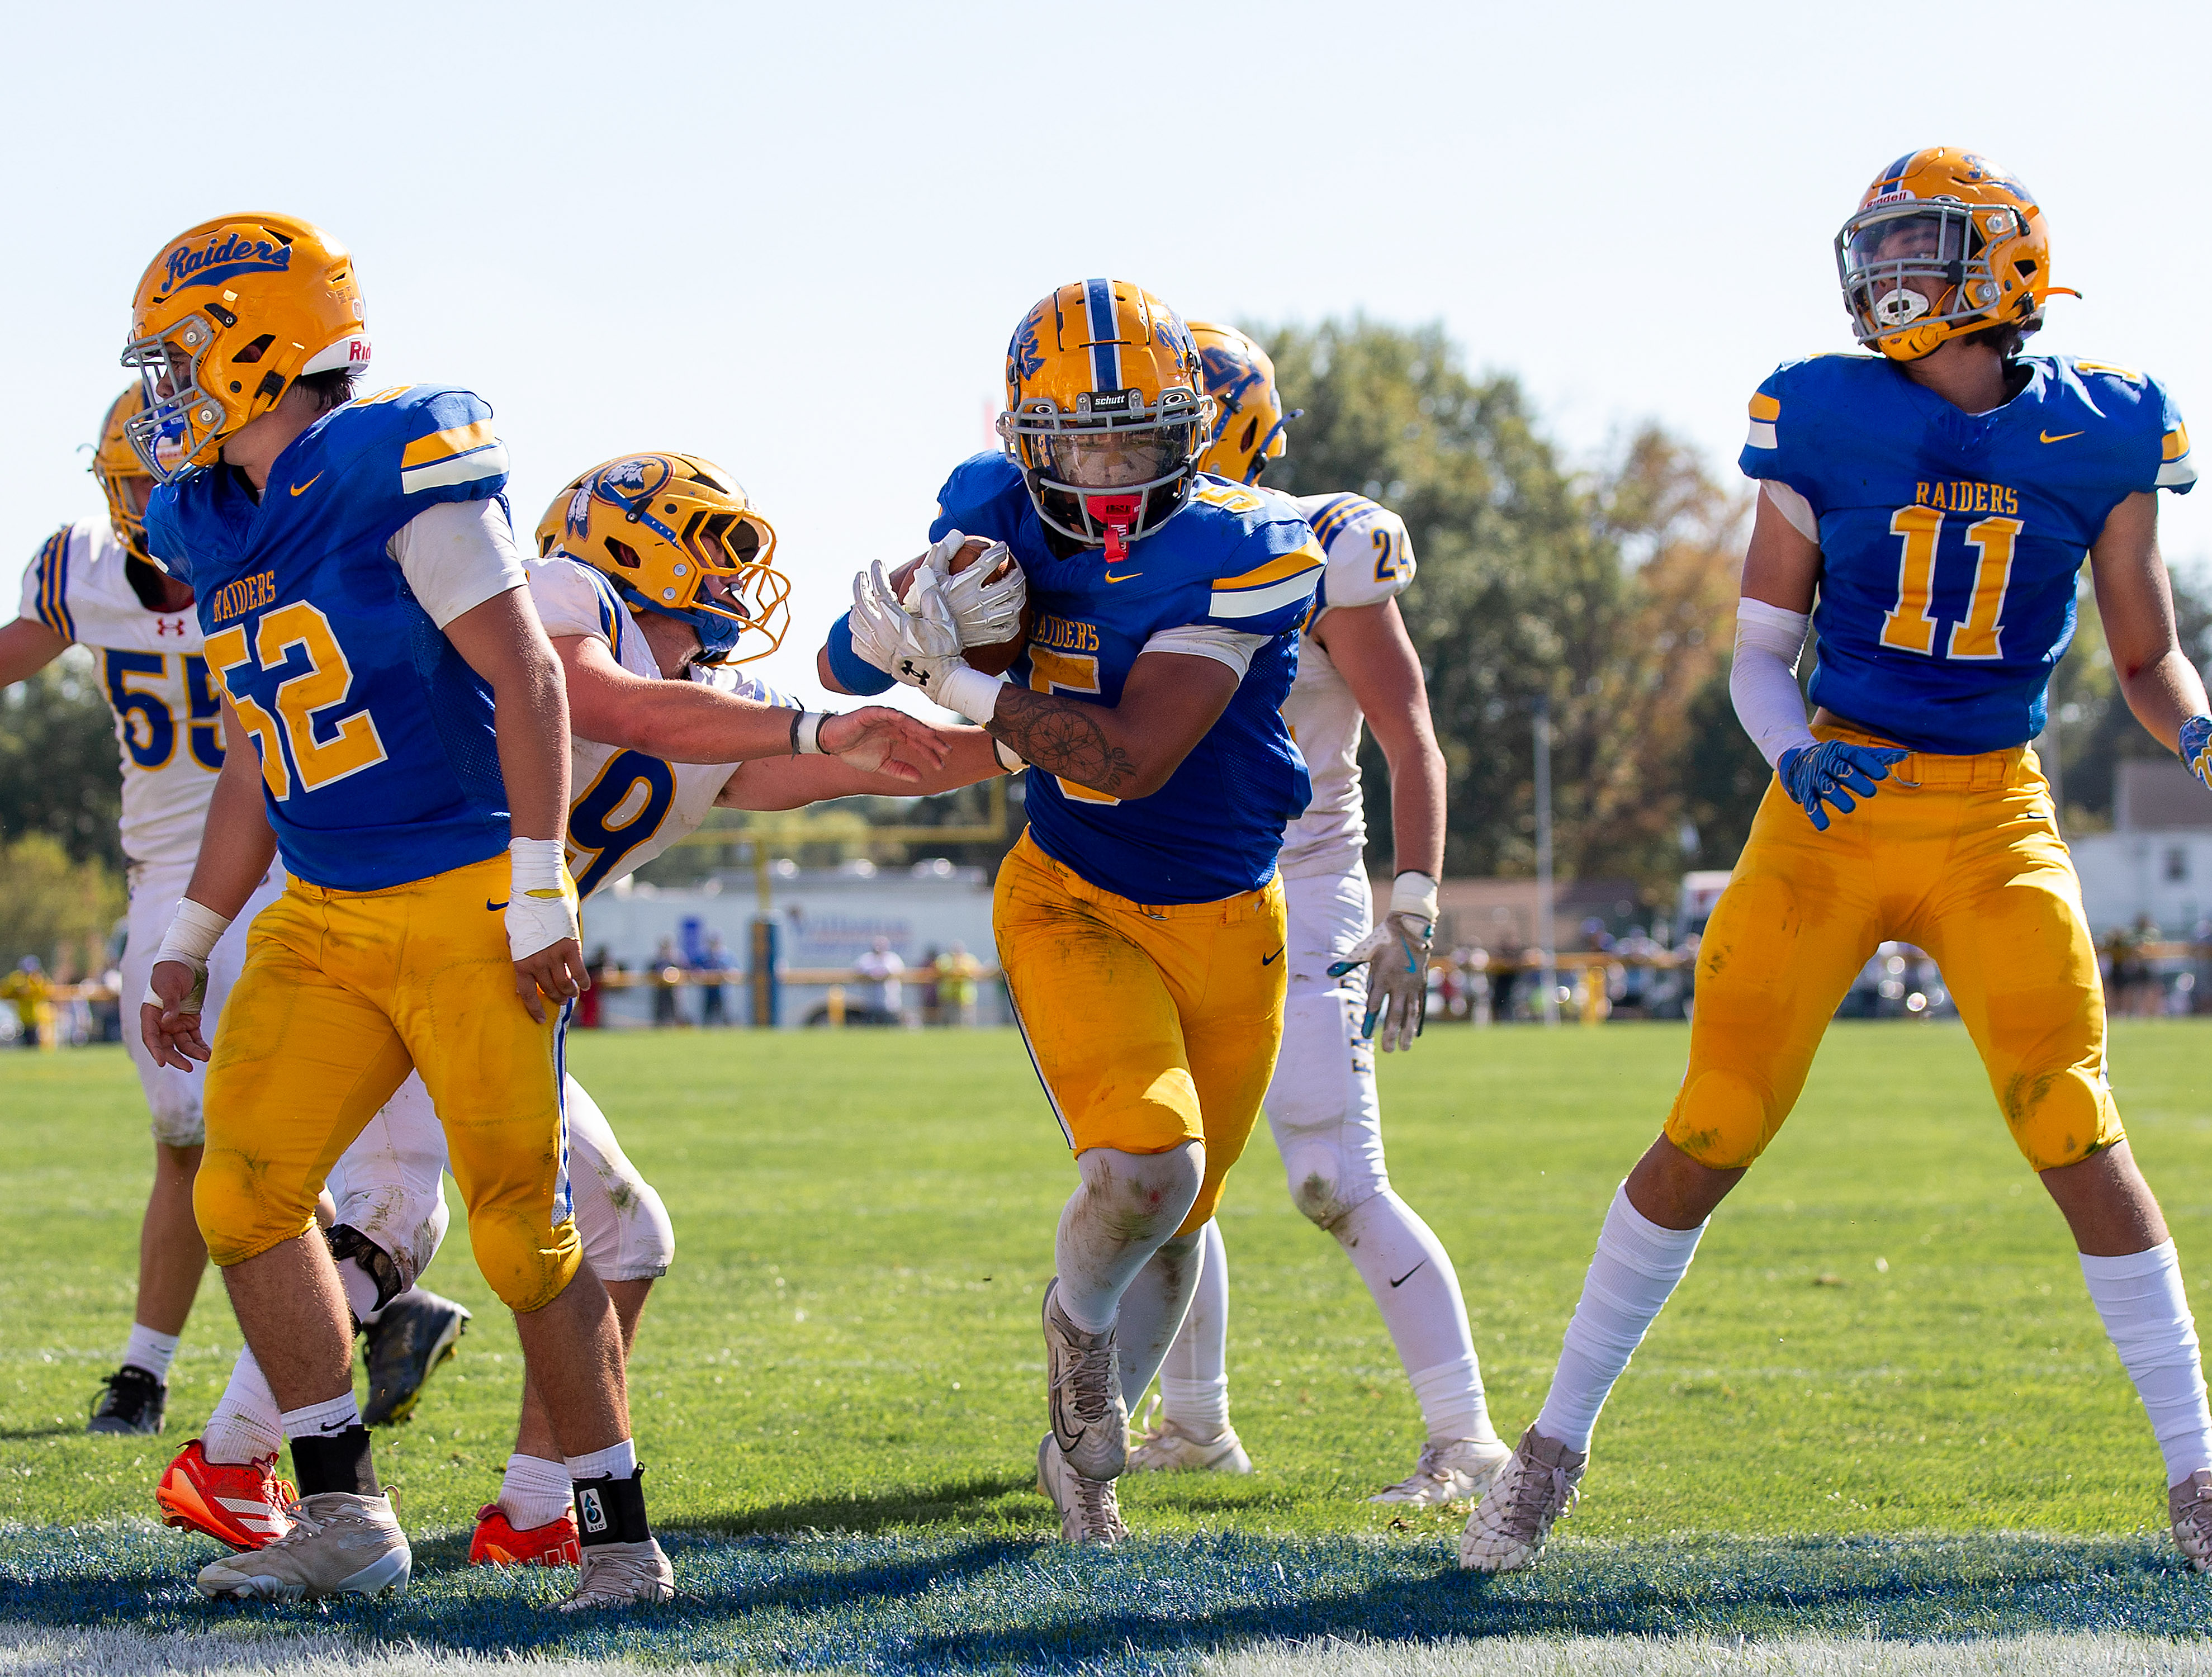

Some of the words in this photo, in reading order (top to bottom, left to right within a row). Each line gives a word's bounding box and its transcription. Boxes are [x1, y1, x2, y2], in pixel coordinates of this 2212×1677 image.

[161, 233, 292, 293] Raiders
[1095, 395, 1125, 405] schutt
[1915, 481, 2019, 515] RAIDERS
[1370, 527, 1414, 582] 24
[1879, 504, 2025, 660] 11
[213, 570, 276, 623] RAIDERS
[203, 599, 389, 802] 52
